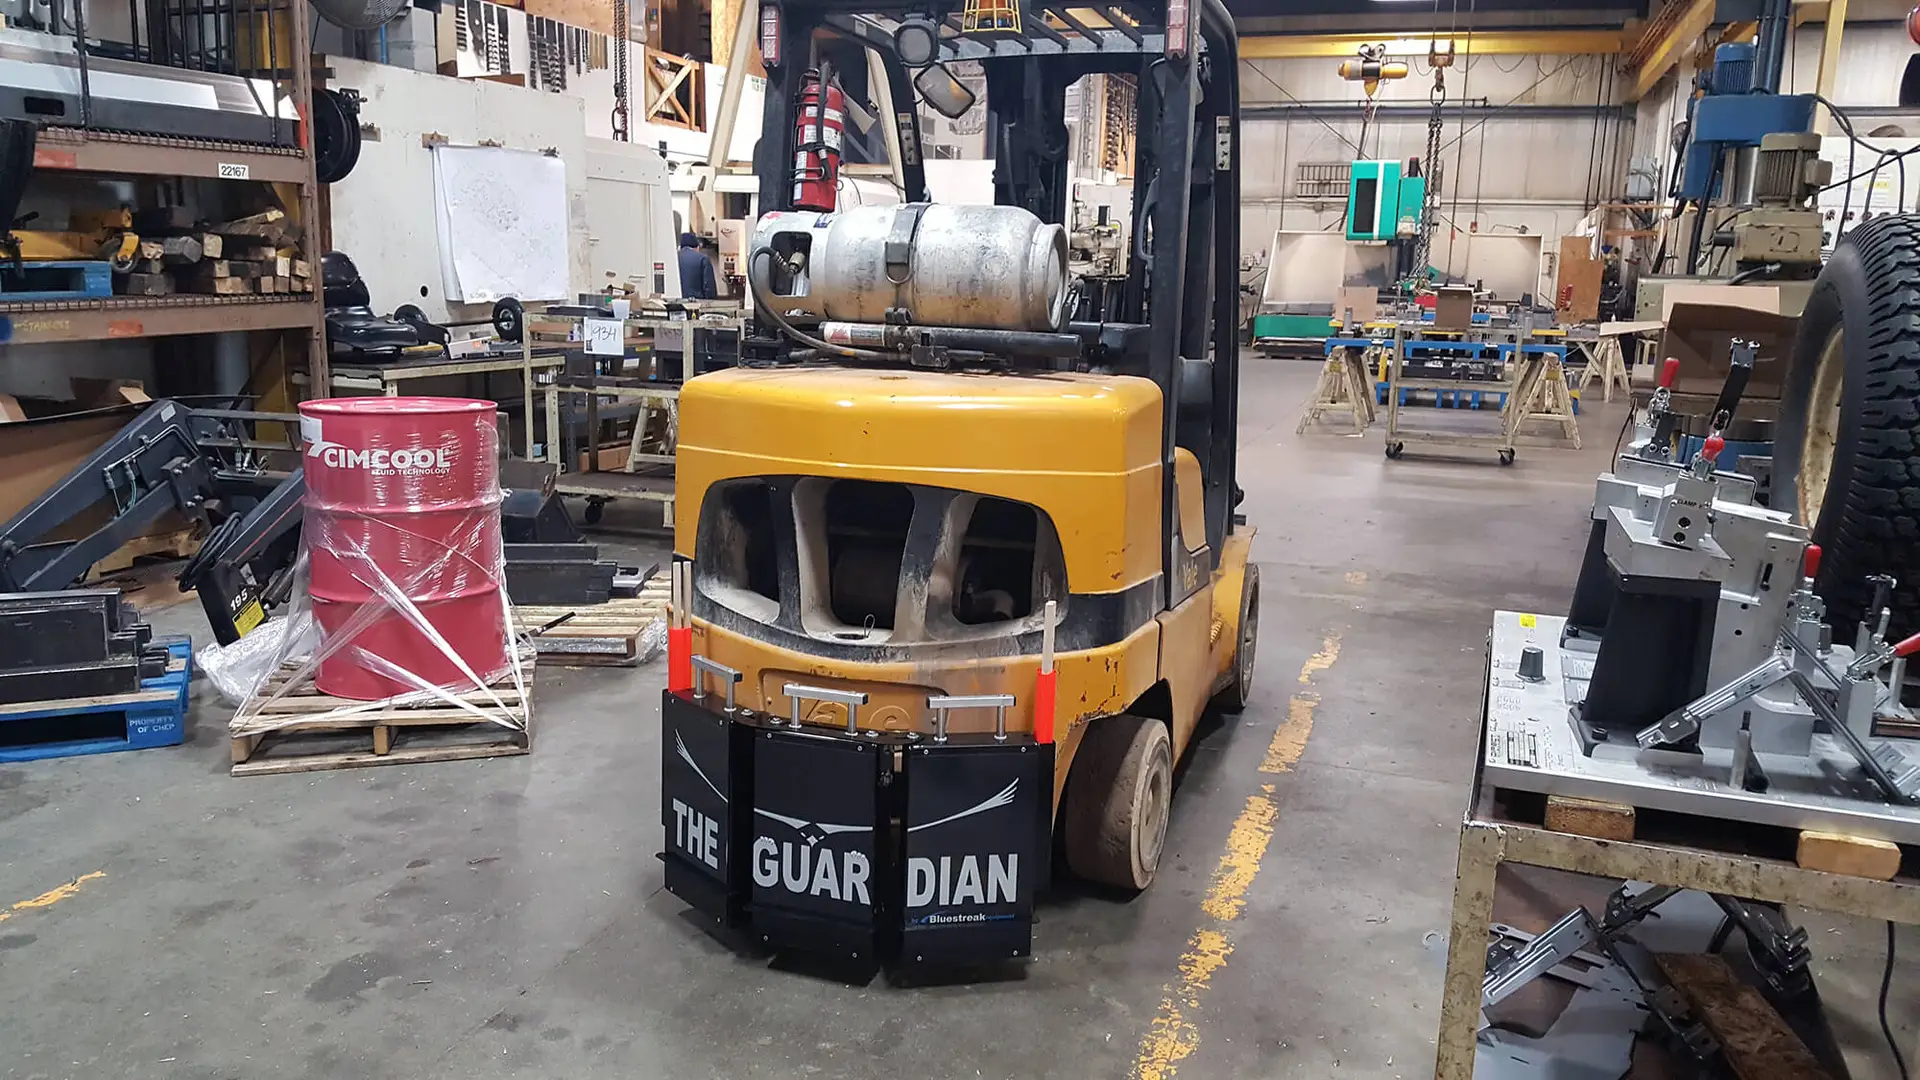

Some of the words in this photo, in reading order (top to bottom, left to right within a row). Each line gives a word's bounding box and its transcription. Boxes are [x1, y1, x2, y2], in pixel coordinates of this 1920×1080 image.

[221, 165, 246, 177] 22167
[324, 448, 450, 469] CIMCOOL
[371, 468, 396, 476] FLUID
[398, 467, 450, 476] TECHNOLOGY
[230, 588, 248, 611] 195
[673, 798, 719, 869] THE
[929, 912, 986, 924] Bluestreak
